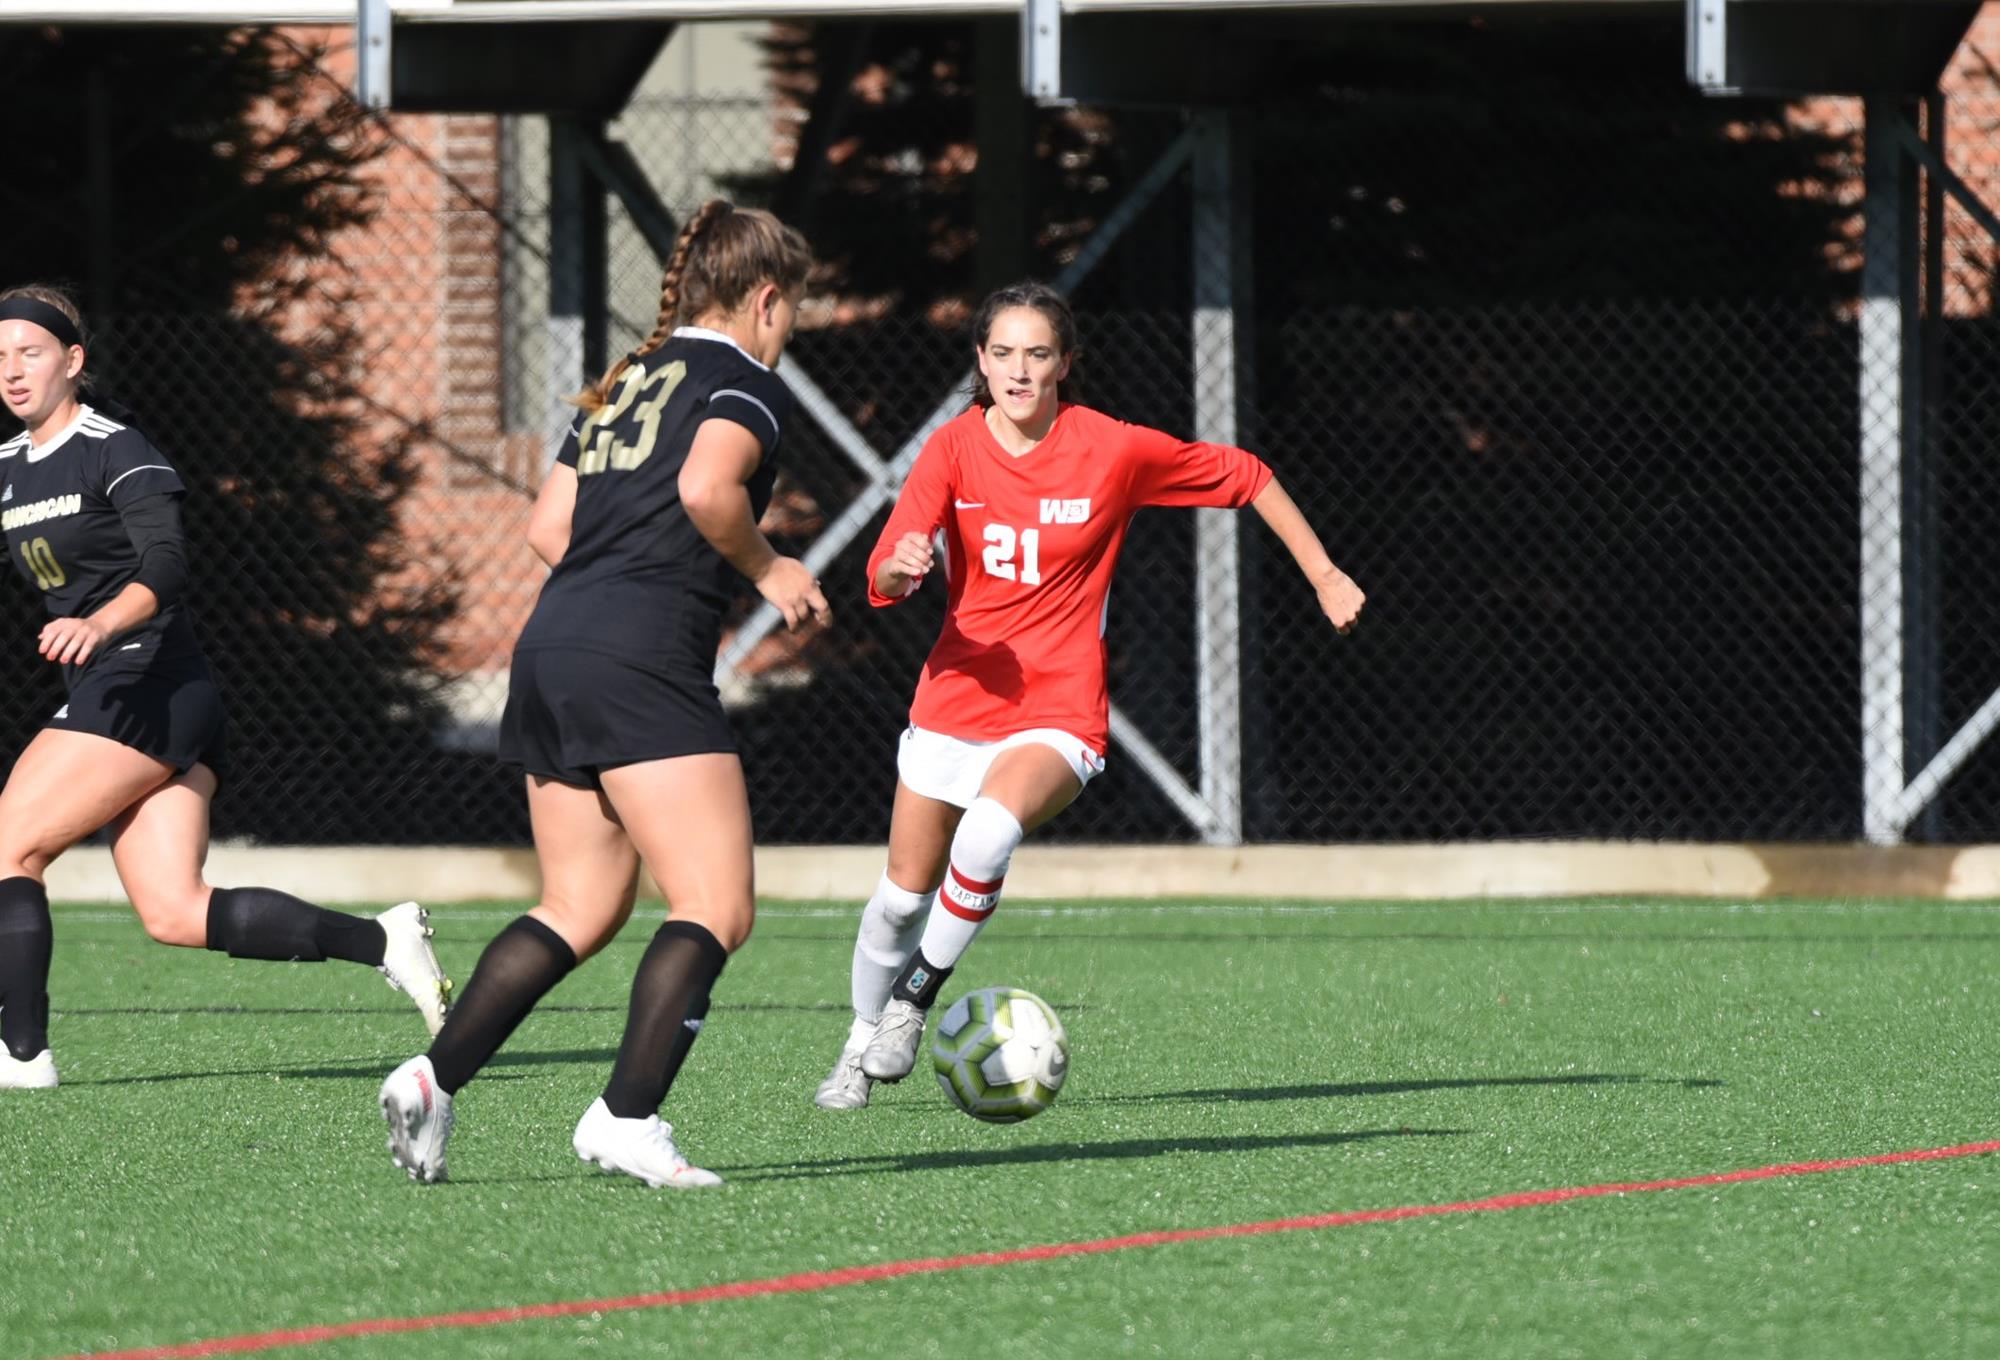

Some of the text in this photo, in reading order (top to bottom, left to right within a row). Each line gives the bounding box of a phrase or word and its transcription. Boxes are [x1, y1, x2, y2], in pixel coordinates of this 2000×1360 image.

[577, 360, 687, 476] 23
[20, 537, 66, 591] 10
[982, 523, 1040, 586] 21
